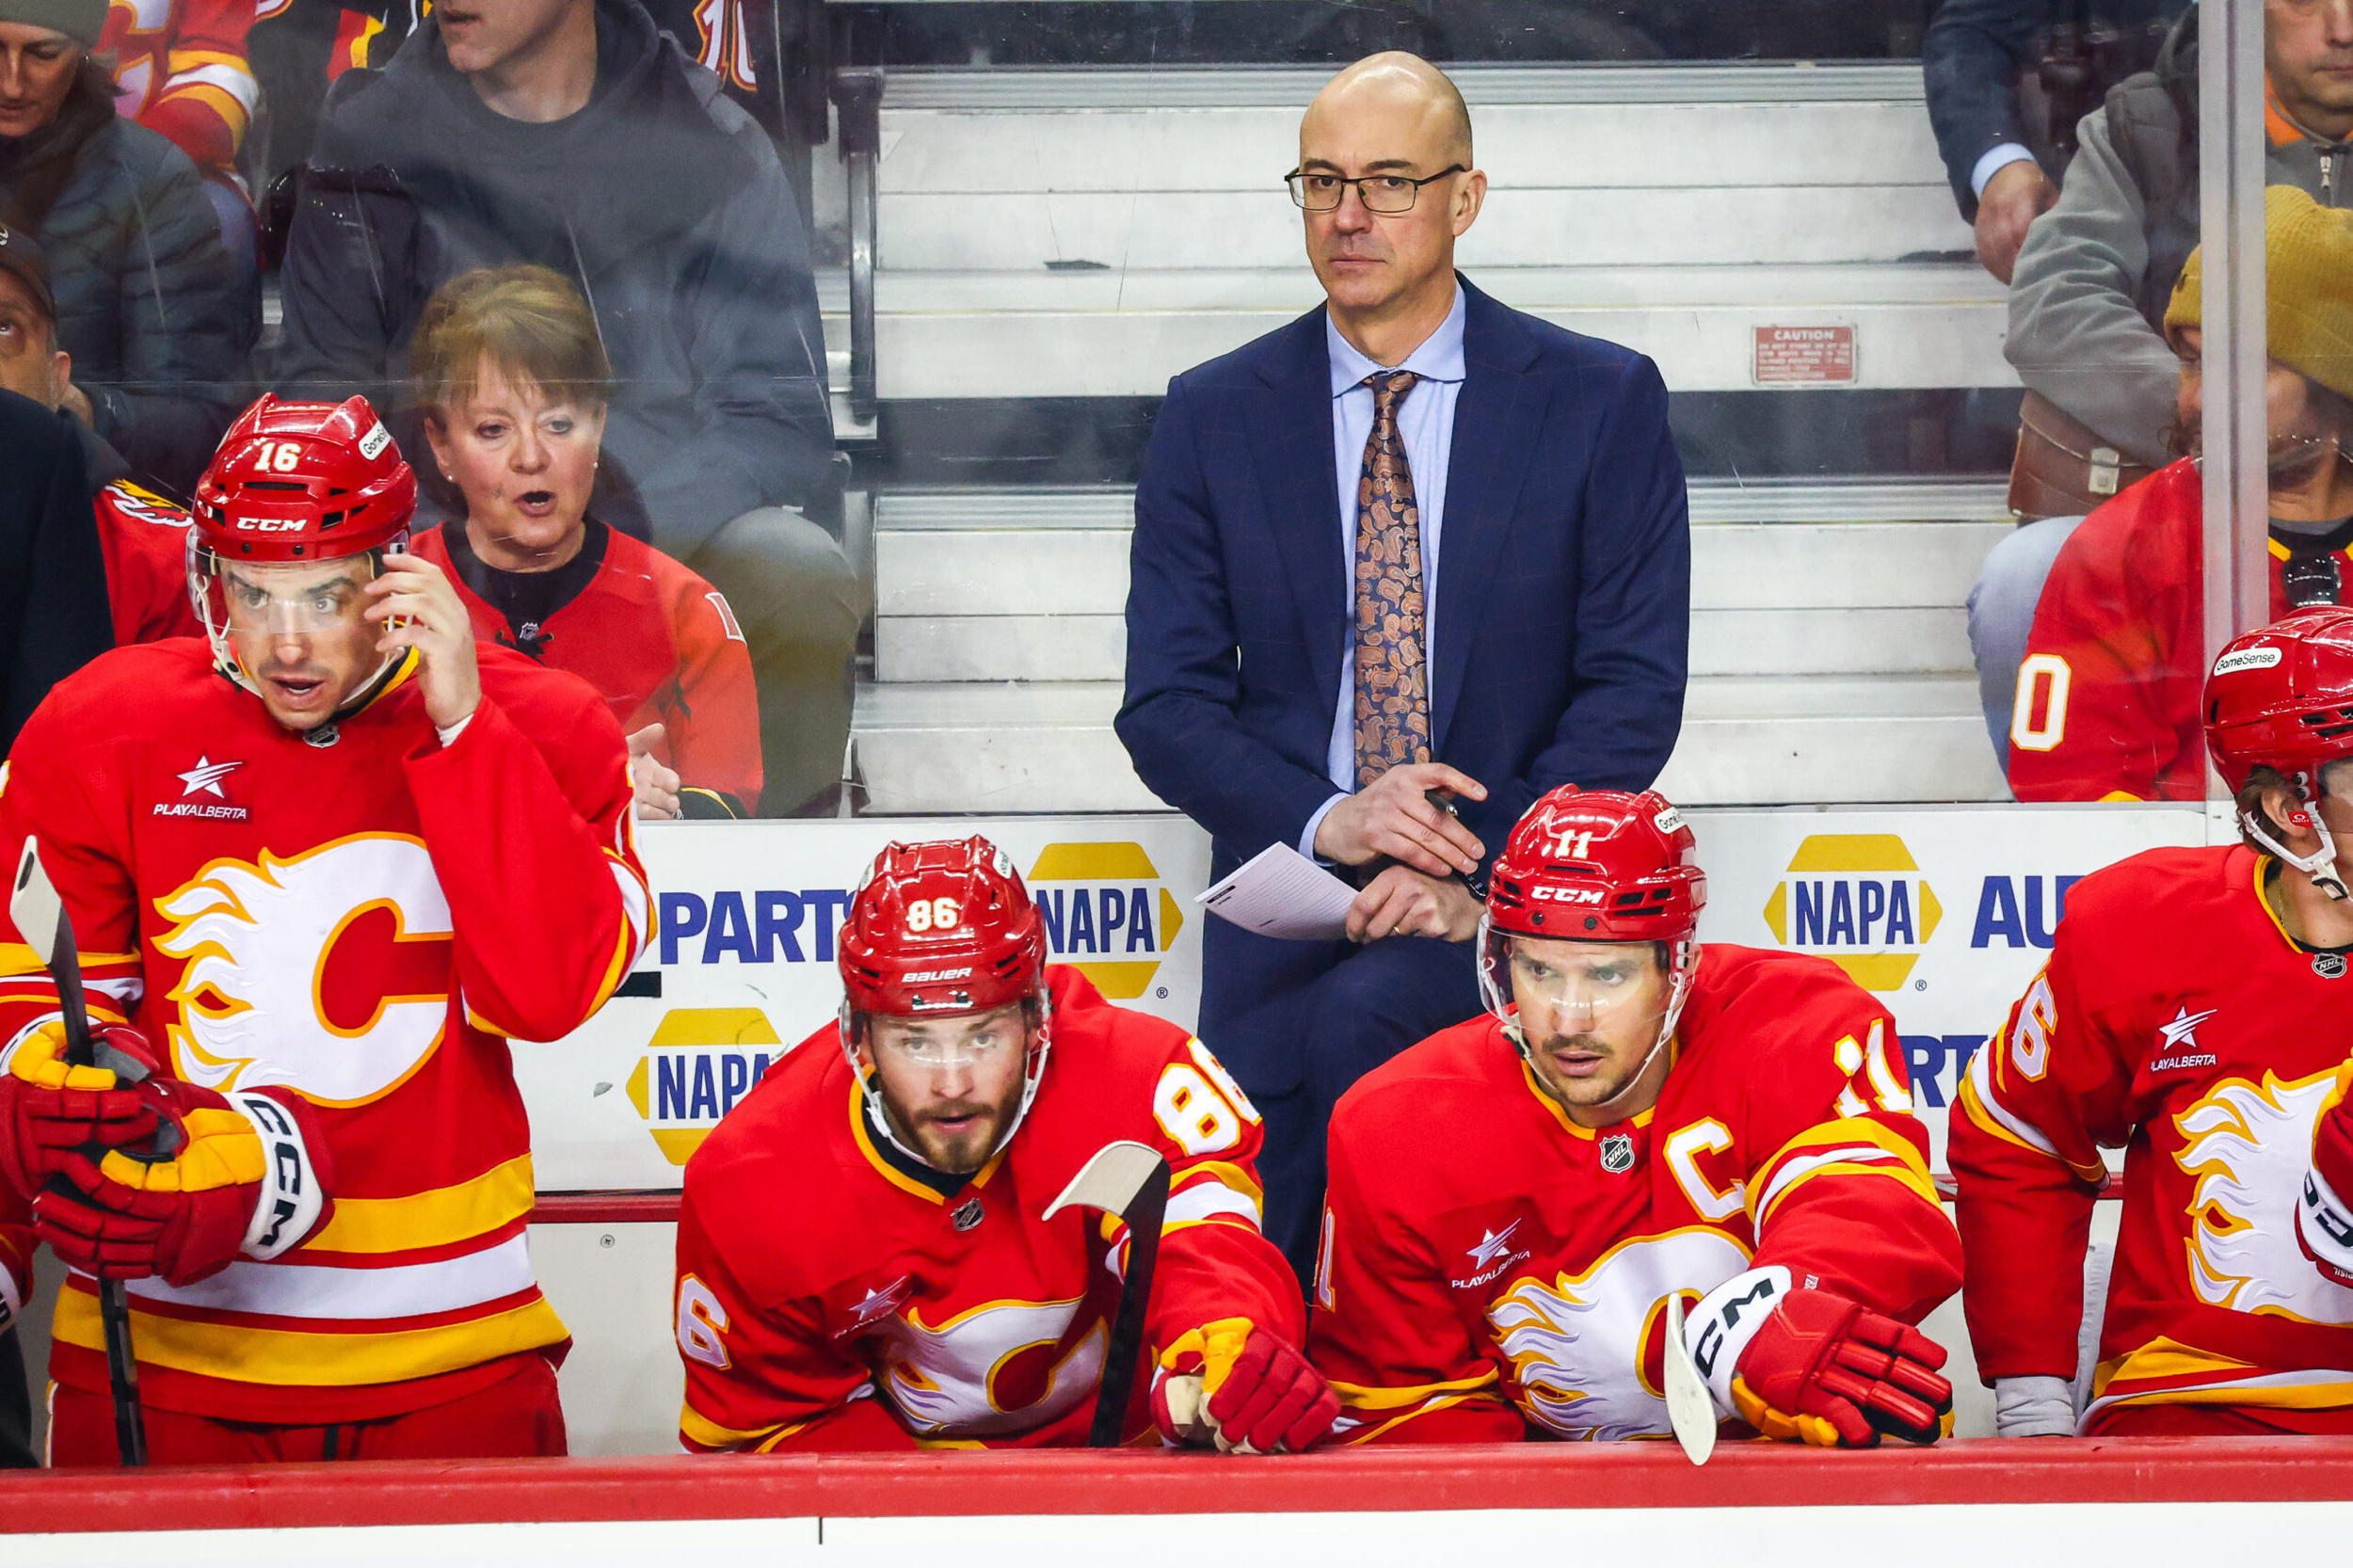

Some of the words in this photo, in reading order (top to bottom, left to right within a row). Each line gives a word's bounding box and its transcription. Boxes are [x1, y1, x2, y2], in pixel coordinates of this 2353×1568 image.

[1773, 329, 1835, 341] CAUTION
[253, 442, 302, 472] 16
[236, 517, 308, 532] CCM
[2217, 653, 2275, 671] GameSense
[2009, 653, 2072, 752] 0
[153, 803, 248, 820] PLAYALBERTA
[1554, 828, 1595, 860] 11
[1530, 885, 1606, 904] CCM
[1970, 874, 2087, 949] AU
[659, 888, 859, 965] PART
[907, 896, 959, 933] 86
[1036, 888, 1156, 954] NAPA
[1796, 880, 1915, 945] NAPA
[2318, 957, 2341, 971] NHL
[1608, 1144, 1626, 1166] NHL
[1662, 1115, 1749, 1224] C
[243, 1098, 302, 1247] CCM
[1694, 1277, 1775, 1403] CM
